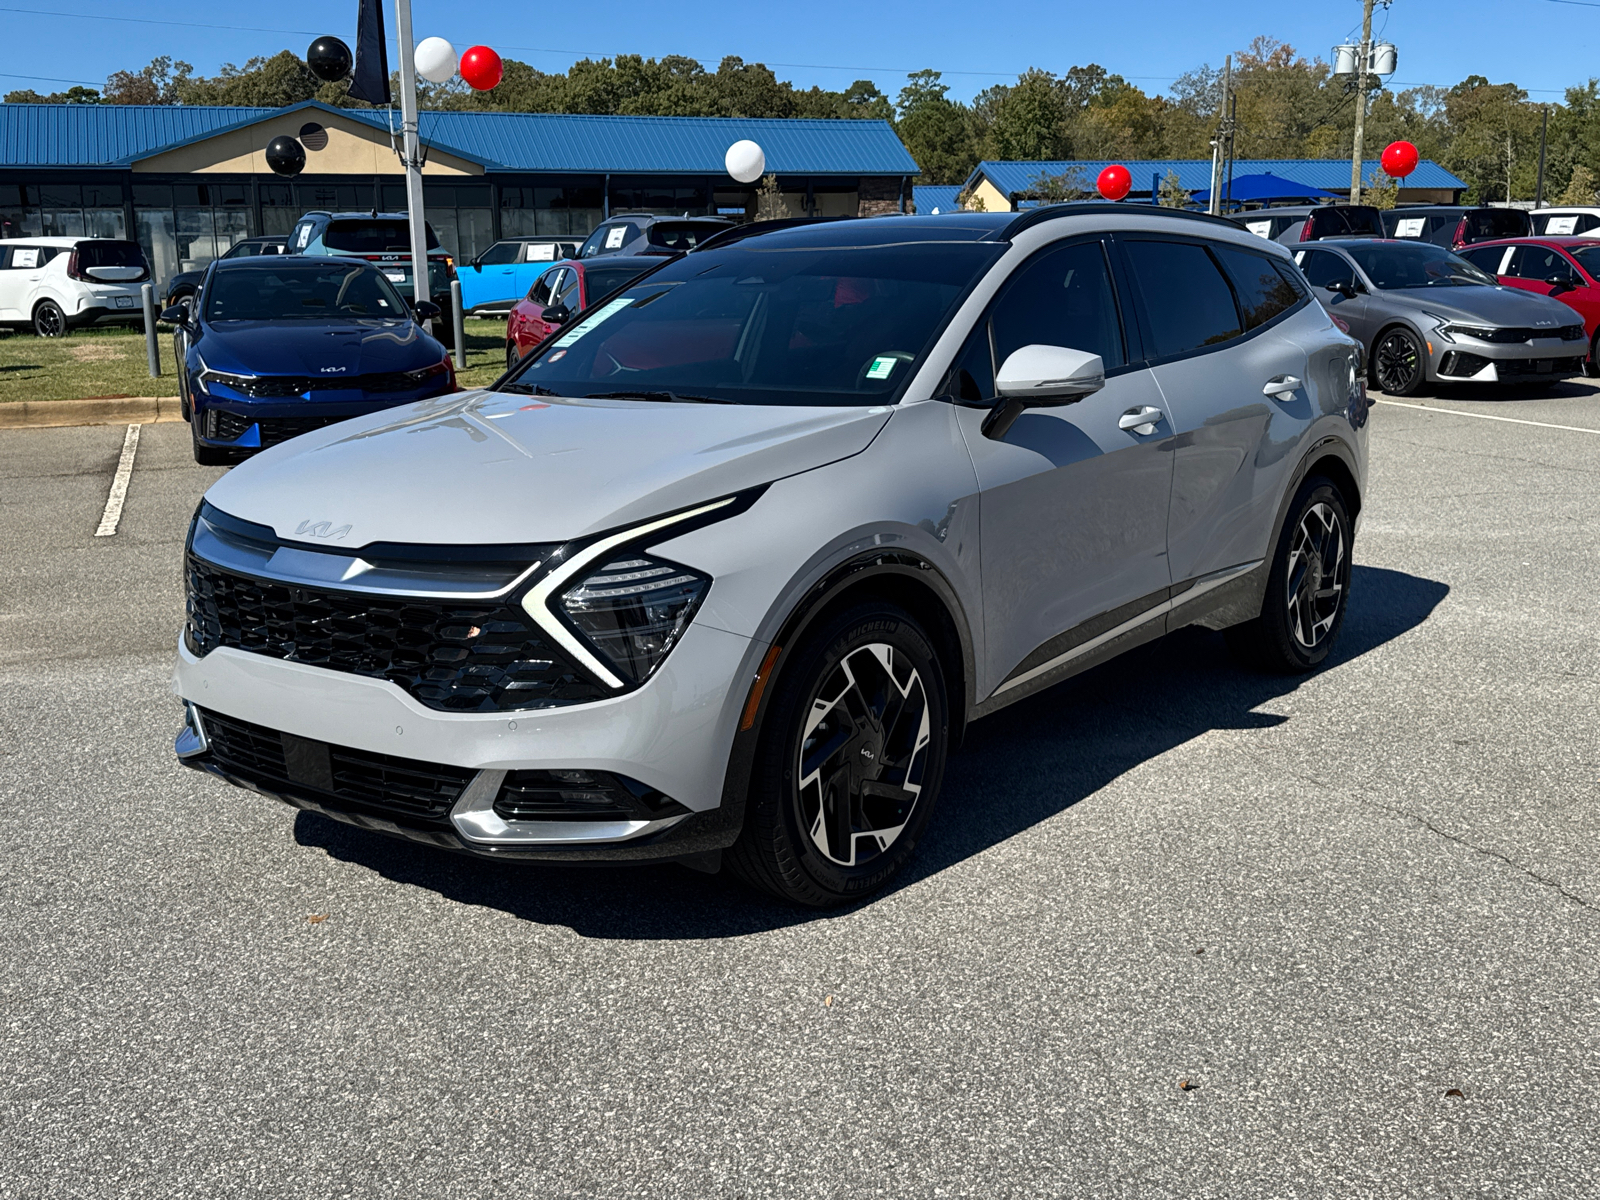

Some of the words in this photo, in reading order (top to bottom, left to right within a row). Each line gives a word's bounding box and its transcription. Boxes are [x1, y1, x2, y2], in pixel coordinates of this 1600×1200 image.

[294, 519, 353, 540] KIA
[848, 621, 897, 643] MICHELIN
[860, 748, 875, 760] KIA
[846, 860, 895, 890] MICHELIN
